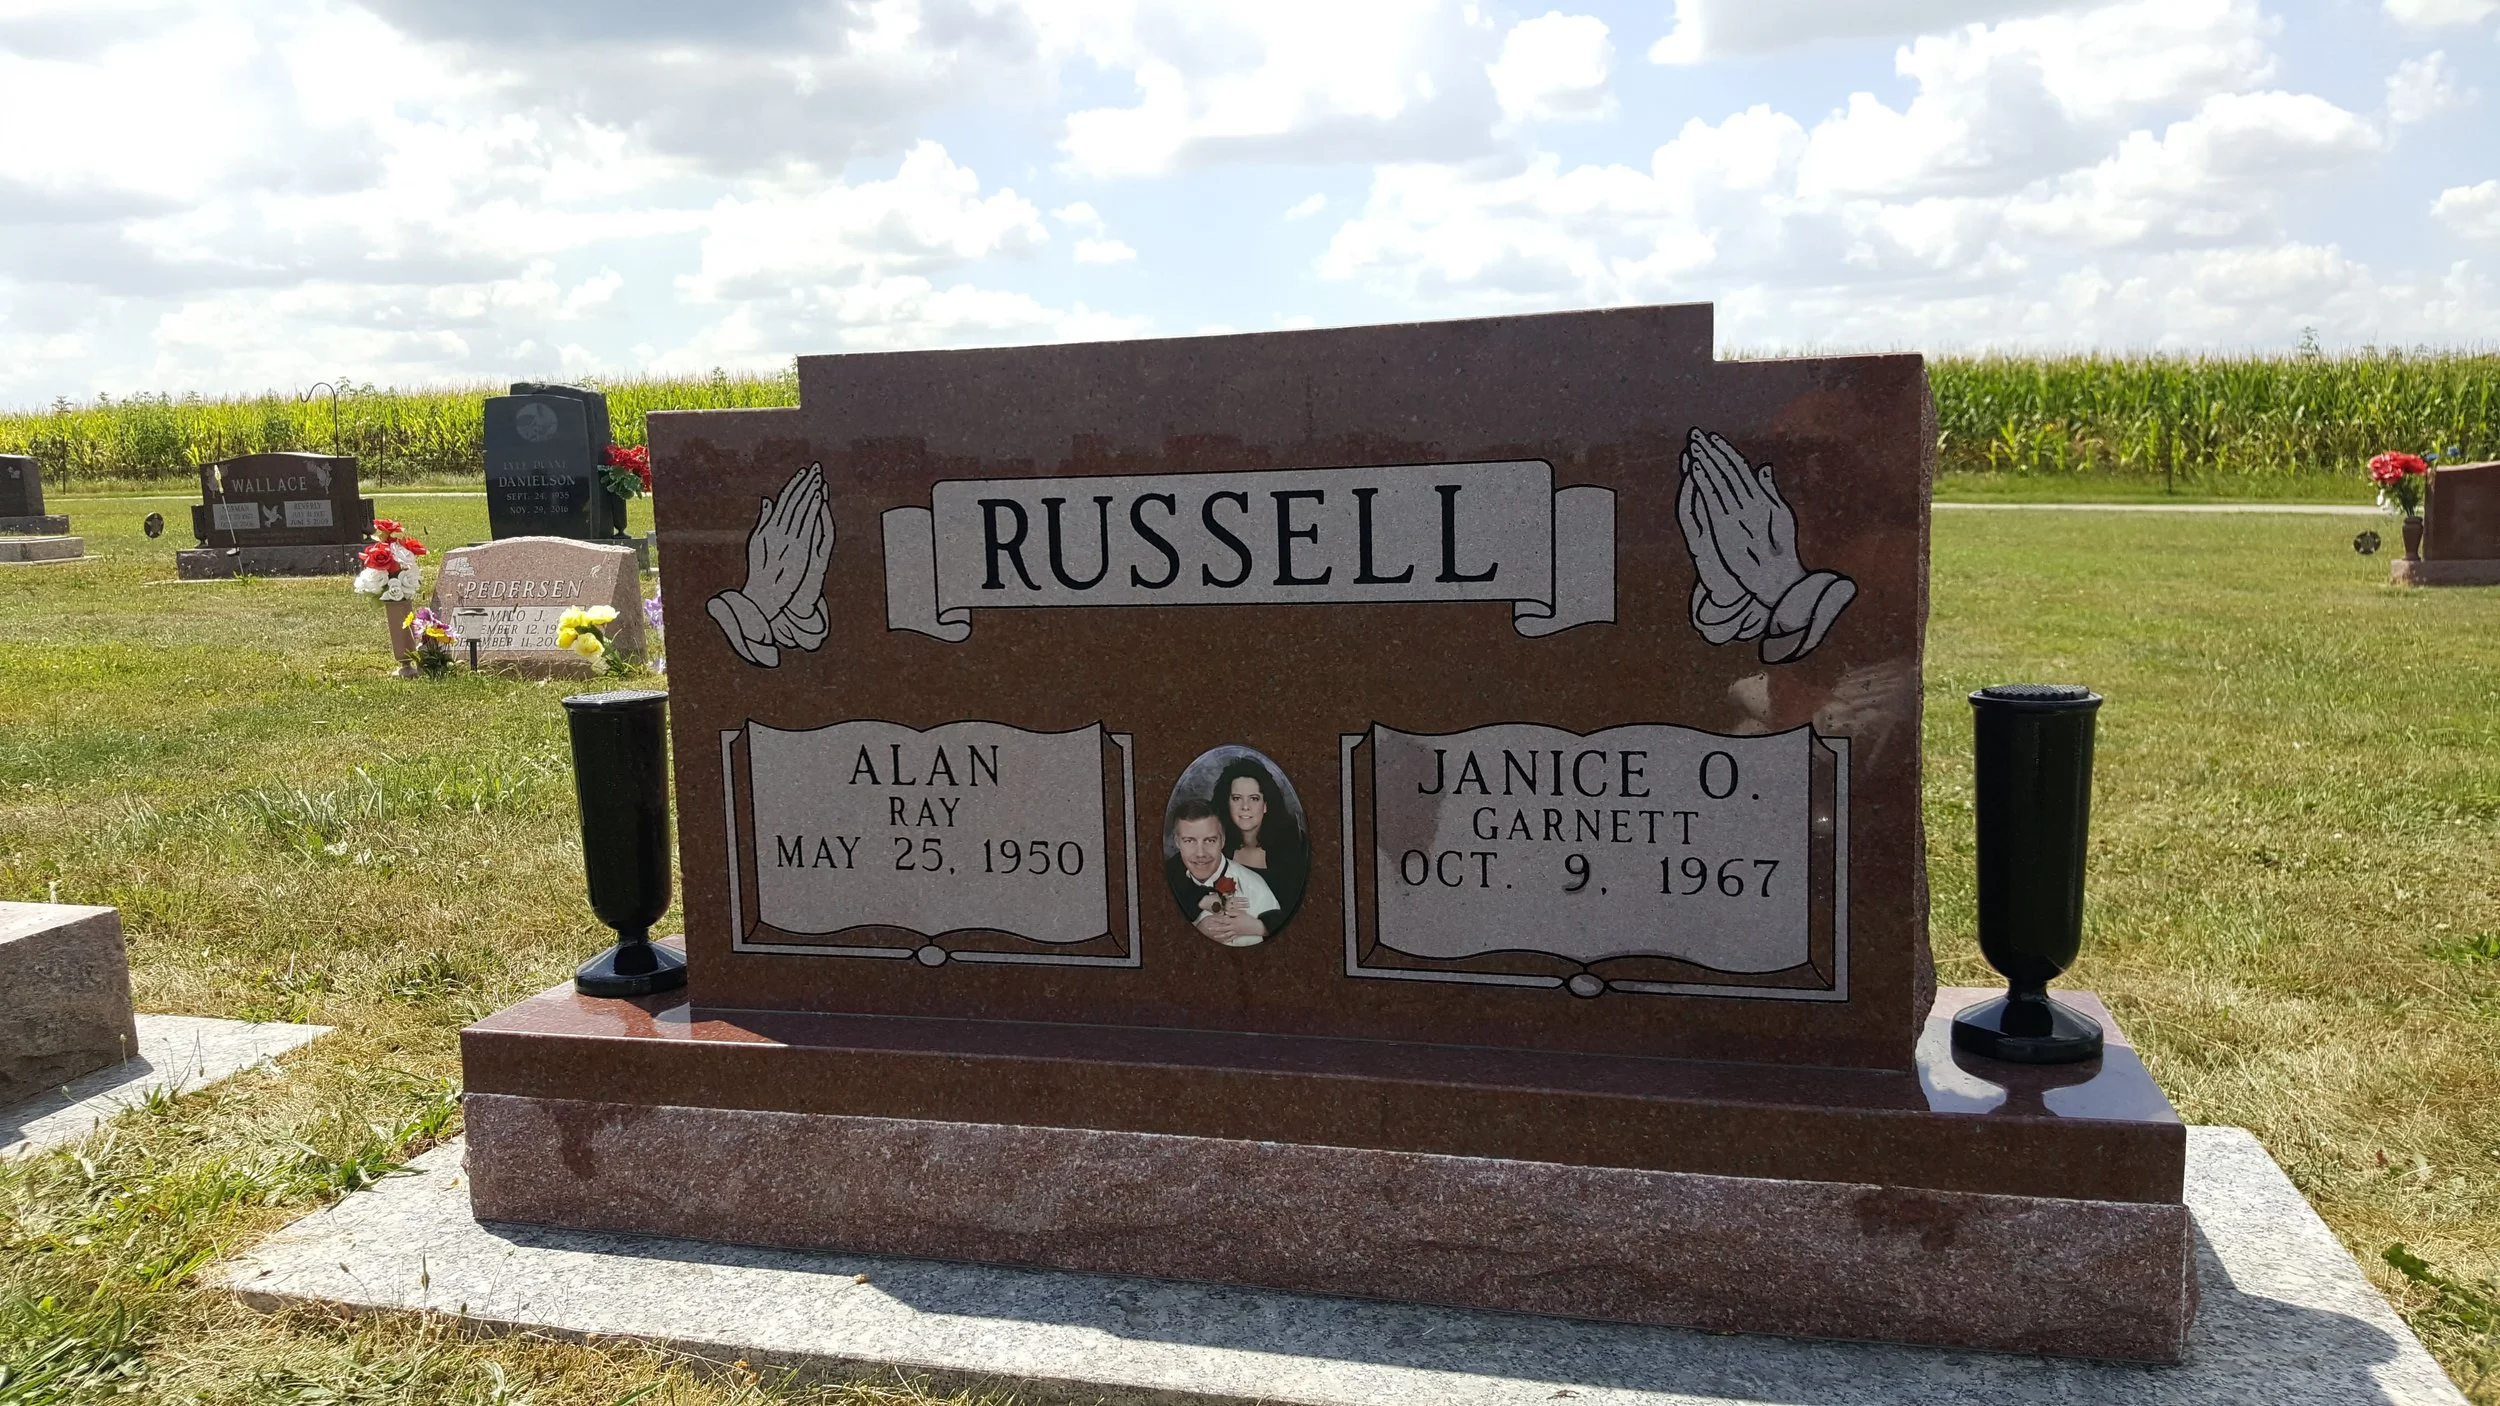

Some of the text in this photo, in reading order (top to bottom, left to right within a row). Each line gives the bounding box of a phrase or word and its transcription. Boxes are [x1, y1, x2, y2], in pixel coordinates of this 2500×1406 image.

[232, 476, 308, 493] WALLACE
[499, 475, 576, 488] DANIELSON
[506, 492, 531, 501] SEPT.
[510, 506, 530, 515] NOV.
[550, 505, 569, 514] 2016
[978, 484, 1499, 591] RUSSELL
[464, 579, 583, 600] PEDERSEN
[489, 610, 546, 622] MILO J.
[457, 624, 519, 635] DEMBER
[848, 744, 999, 787] ALAN
[1418, 749, 1760, 801] JANICE O.
[889, 797, 960, 828] RAY
[1472, 806, 1699, 845] GARNETT
[776, 835, 1085, 876] MAY 25, 1950
[1400, 850, 1780, 898] OCT. 9, 1967
